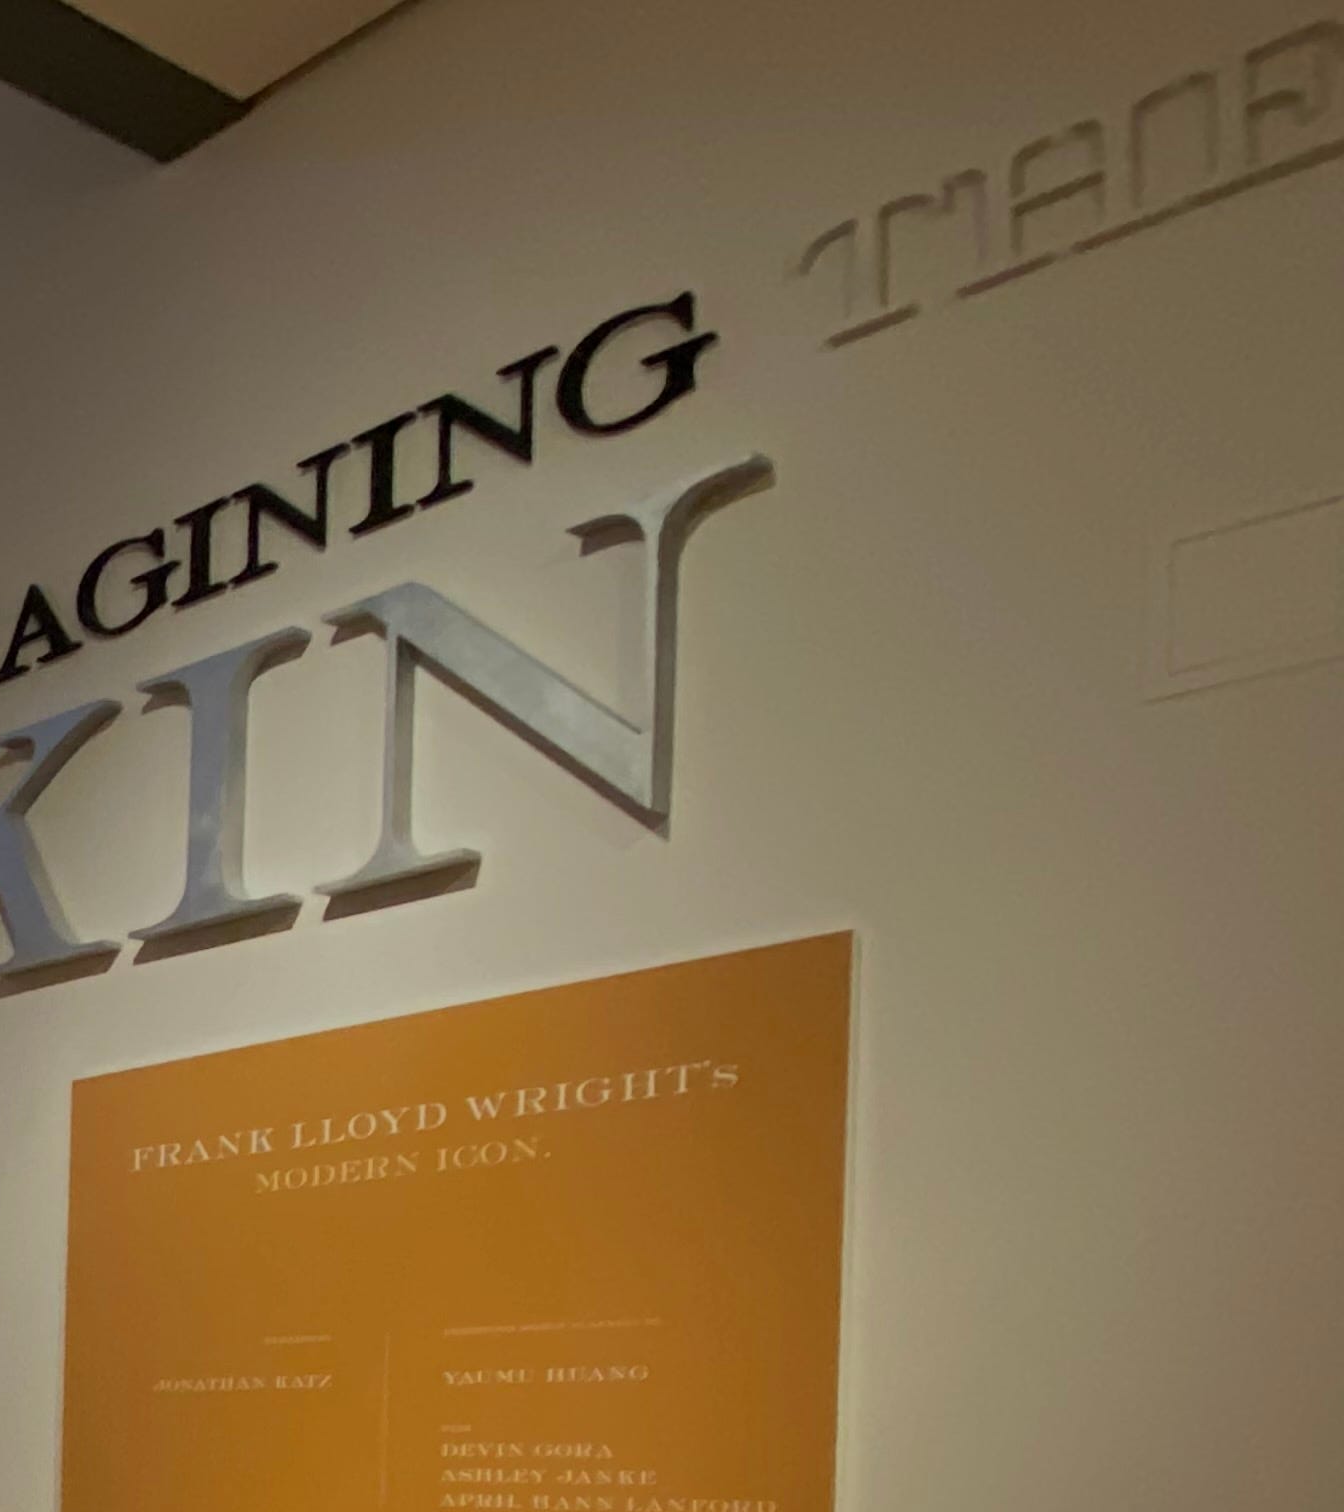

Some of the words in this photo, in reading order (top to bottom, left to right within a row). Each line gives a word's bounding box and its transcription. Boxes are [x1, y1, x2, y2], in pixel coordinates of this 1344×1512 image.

[129, 1127, 275, 1172] FRANK
[289, 1101, 448, 1148] LLOYD
[253, 1151, 420, 1195] MODERN
[436, 1136, 552, 1172] ICON.
[275, 1374, 333, 1390] KATZ
[440, 1441, 525, 1459] DEVIN
[440, 1467, 548, 1484] ASHLEY
[438, 1493, 523, 1510] APRIL
